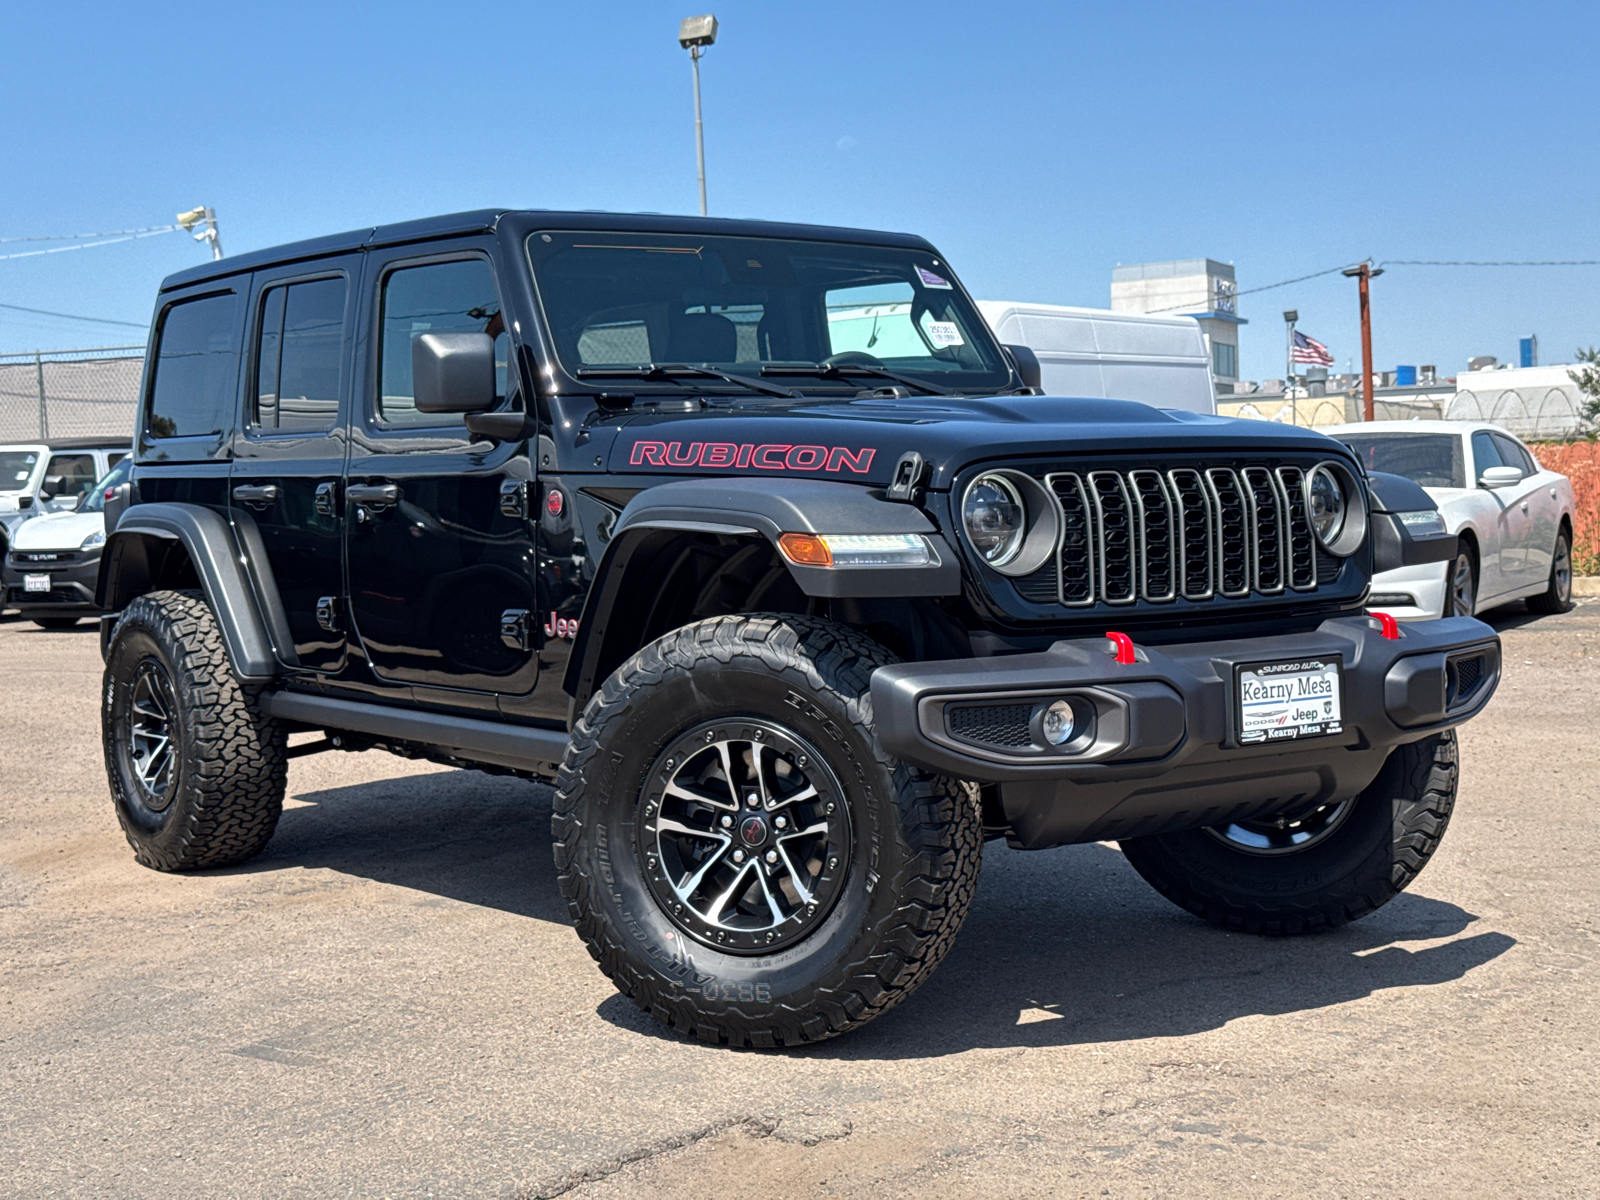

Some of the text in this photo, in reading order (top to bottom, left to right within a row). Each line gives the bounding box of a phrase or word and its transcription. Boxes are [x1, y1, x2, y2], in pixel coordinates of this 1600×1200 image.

[629, 440, 877, 474] RUBICON
[543, 610, 579, 639] Jee
[1262, 661, 1320, 673] SUNROAD AUTO
[1243, 677, 1332, 703] Kearny Mesa
[1245, 716, 1281, 726] DODGE
[1292, 708, 1318, 722] Jeep
[1268, 724, 1321, 738] Kearny Mesa
[597, 751, 625, 806] T/A
[783, 689, 884, 894] BFGoodrich
[596, 823, 717, 986] All-Terrain
